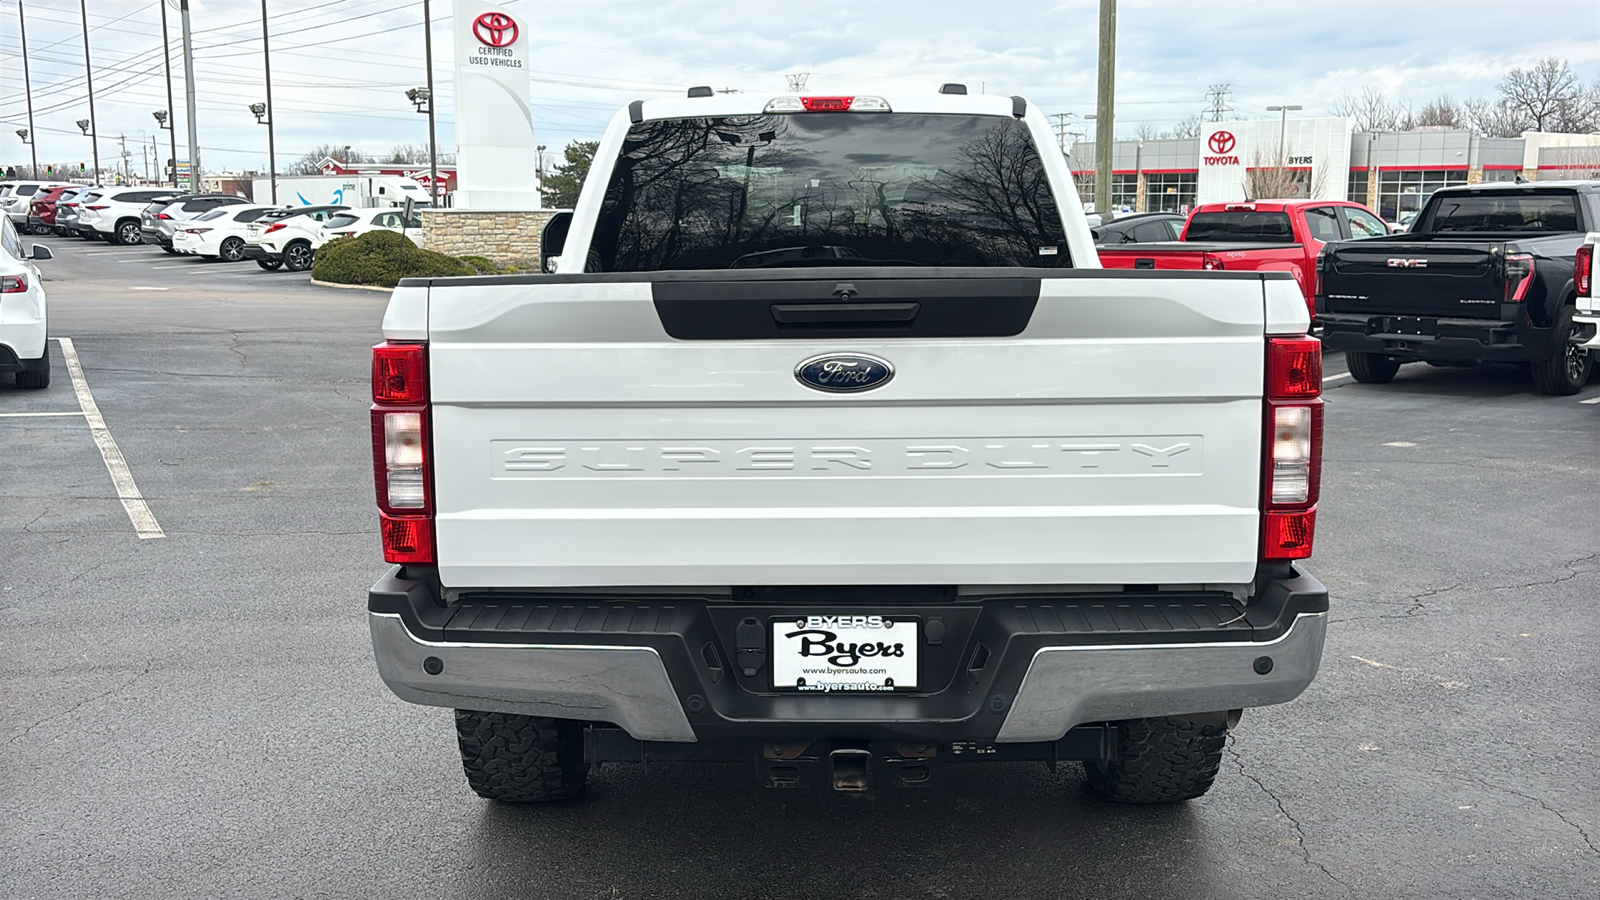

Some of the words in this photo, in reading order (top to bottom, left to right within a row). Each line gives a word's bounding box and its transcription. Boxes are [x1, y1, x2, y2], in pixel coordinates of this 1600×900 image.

[478, 46, 513, 57] CERTIFIED
[469, 56, 489, 66] USED
[490, 57, 522, 68] VEHICLES
[1203, 156, 1240, 165] TOYOTA
[1289, 156, 1313, 165] BYERS
[342, 181, 356, 192] prime
[1387, 258, 1428, 268] GMC
[818, 360, 872, 384] Ford
[504, 445, 872, 472] SUPER
[905, 442, 1191, 470] DUTY
[806, 615, 883, 629] BYERS
[784, 629, 905, 668] Byers
[802, 666, 887, 676] www.byersauto.com
[798, 680, 894, 693] www.byersauto.com
